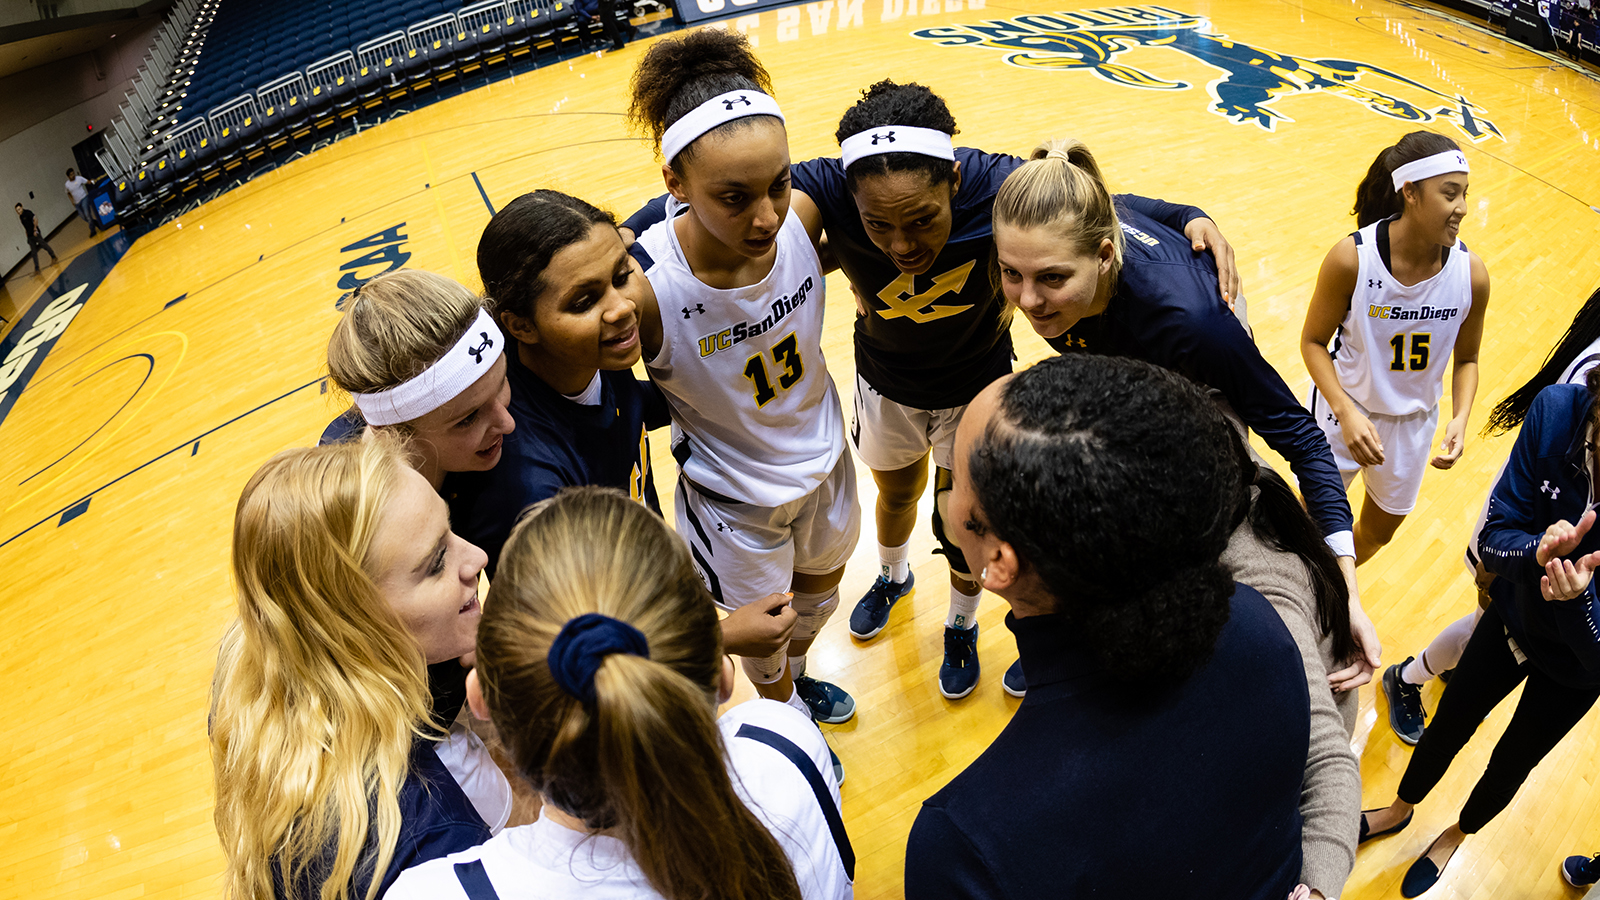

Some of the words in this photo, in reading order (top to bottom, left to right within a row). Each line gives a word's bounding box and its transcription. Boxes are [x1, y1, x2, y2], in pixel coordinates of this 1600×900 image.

[909, 4, 1205, 47] TRITONS
[335, 221, 412, 312] CAA
[742, 330, 805, 410] 13
[1389, 332, 1432, 372] 15
